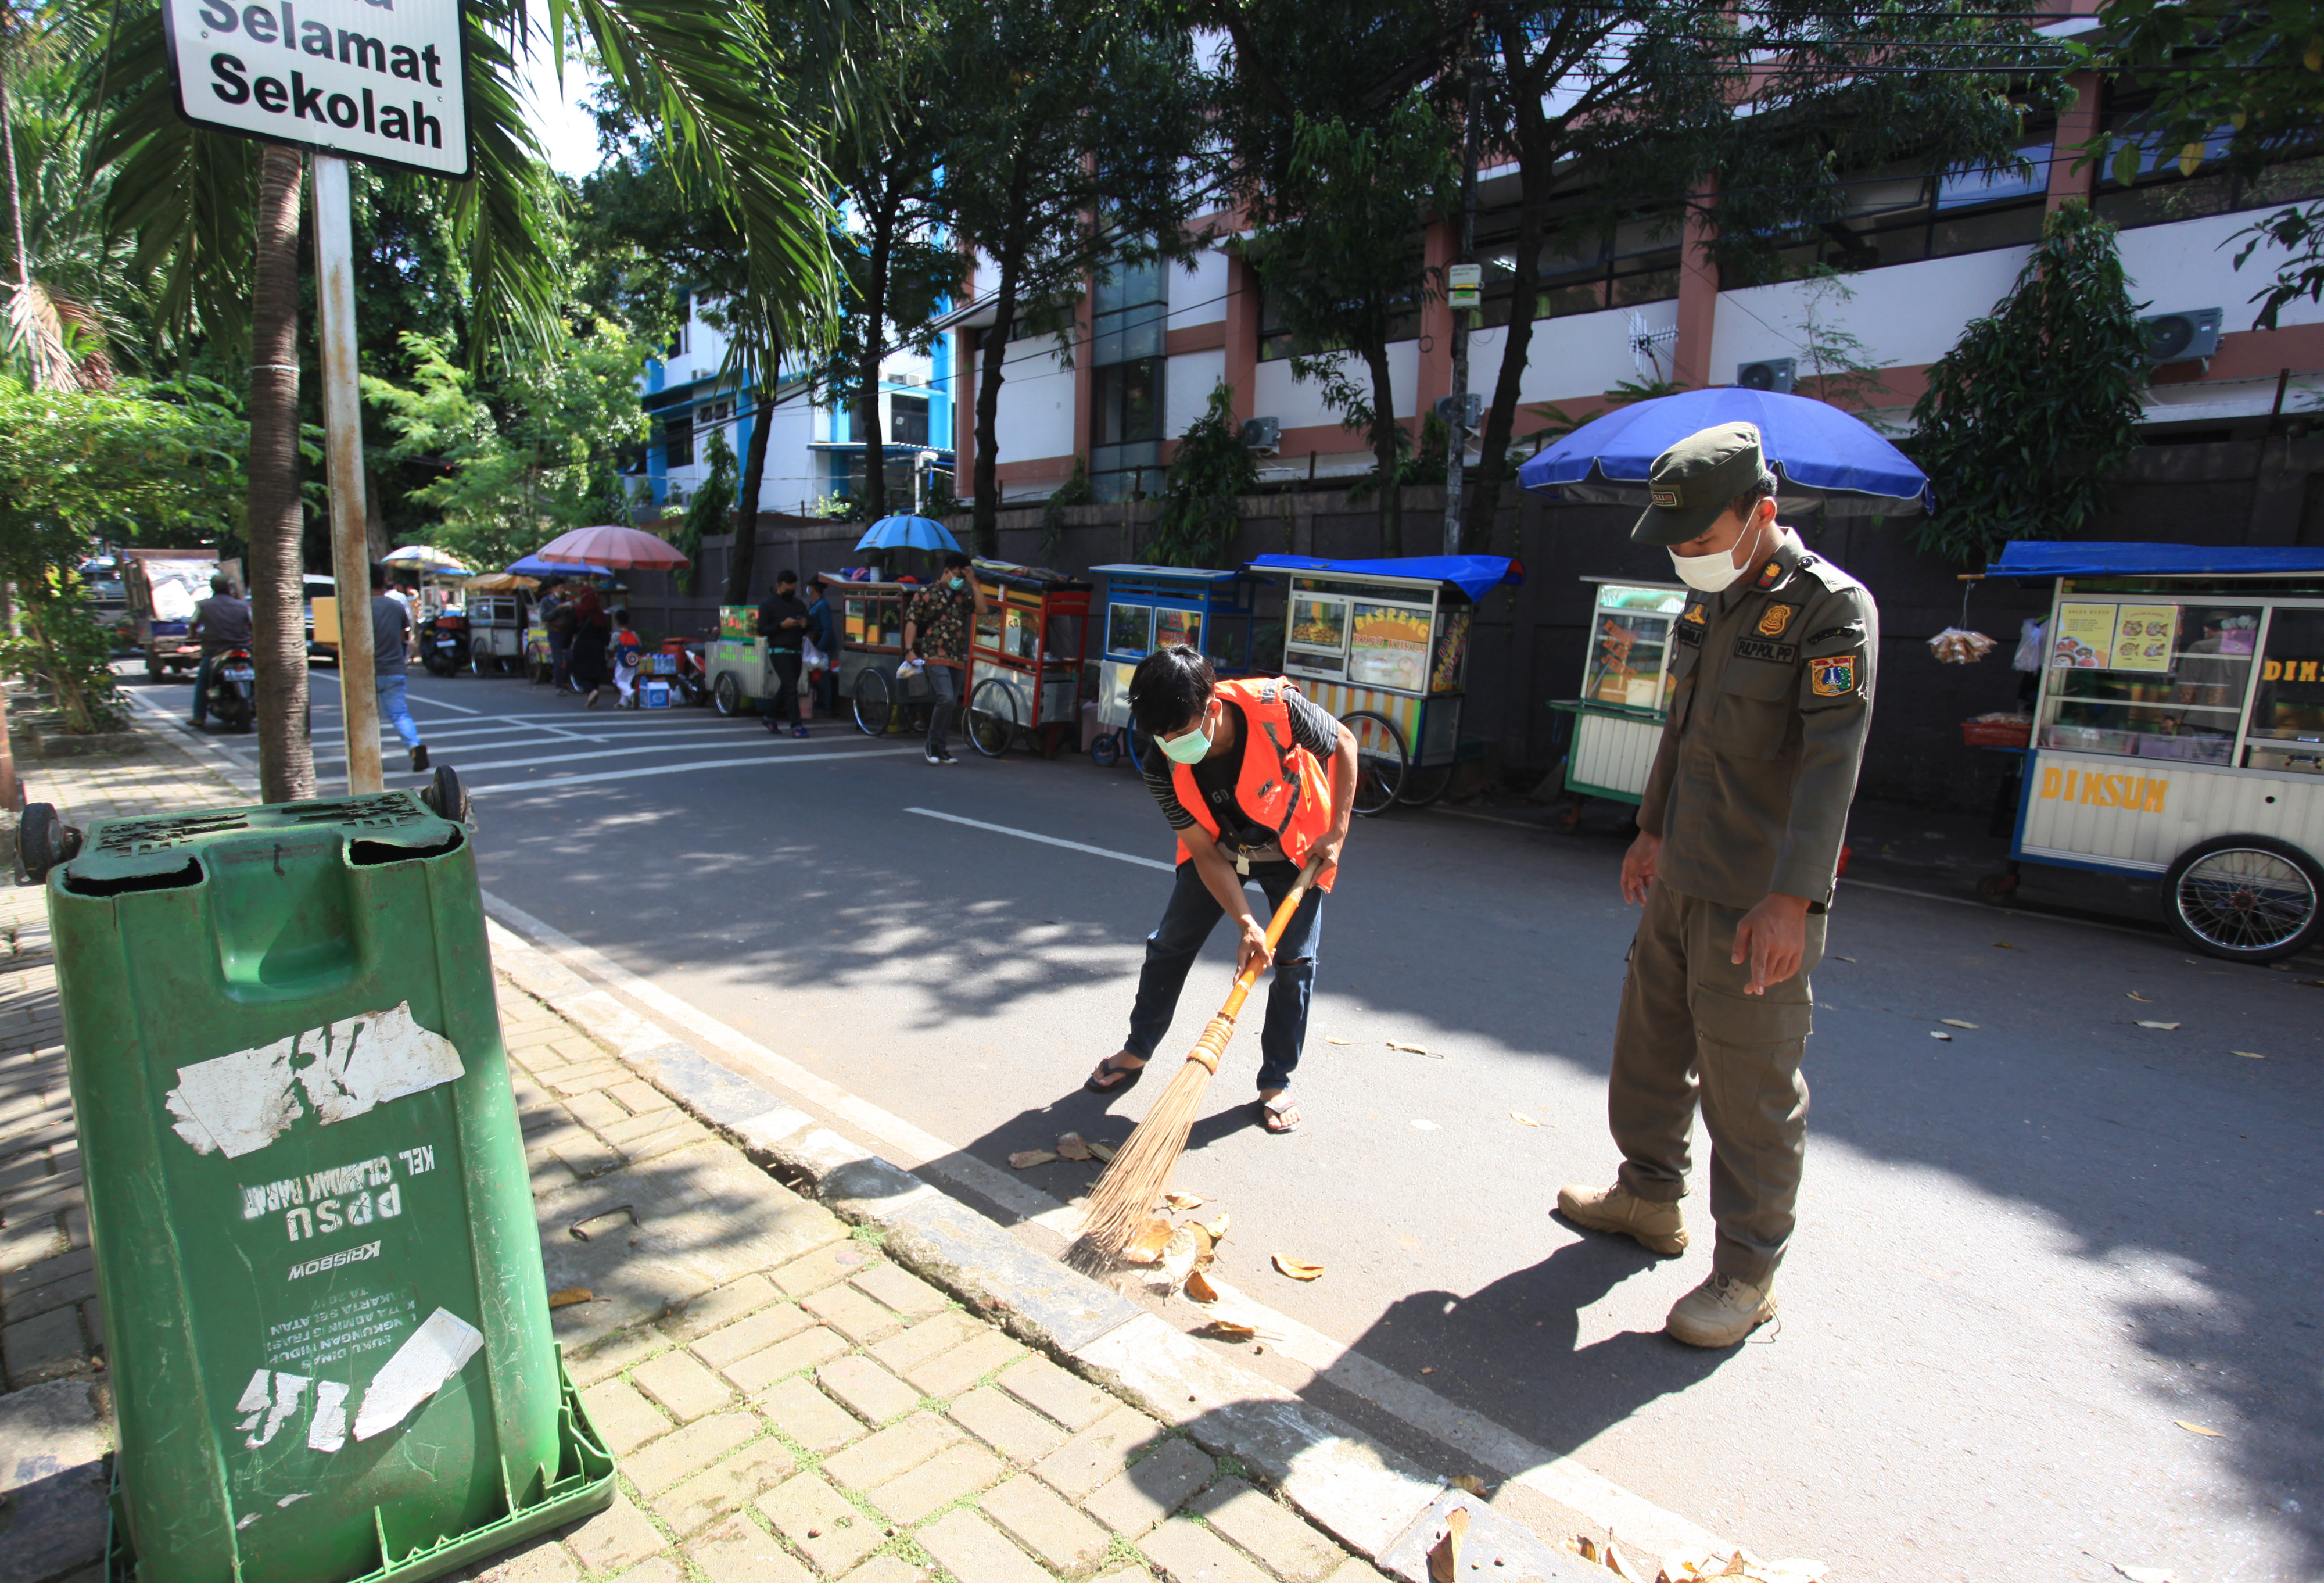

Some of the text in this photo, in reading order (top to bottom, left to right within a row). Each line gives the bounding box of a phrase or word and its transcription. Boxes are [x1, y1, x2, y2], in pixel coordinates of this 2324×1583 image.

[199, 0, 443, 88] Selamat
[211, 53, 442, 149] Sekolah
[1354, 608, 1429, 638] BASRENG
[1353, 633, 1428, 655] BASO KUKUS
[1776, 646, 1793, 661] PP
[2040, 767, 2169, 814] DIMSUM
[399, 1144, 435, 1176] KEL.
[243, 1176, 304, 1220] BARAT
[286, 1183, 401, 1242] PPSU
[288, 1240, 381, 1281] KRISBOW
[321, 1313, 417, 1351] LNGKUNGAN
